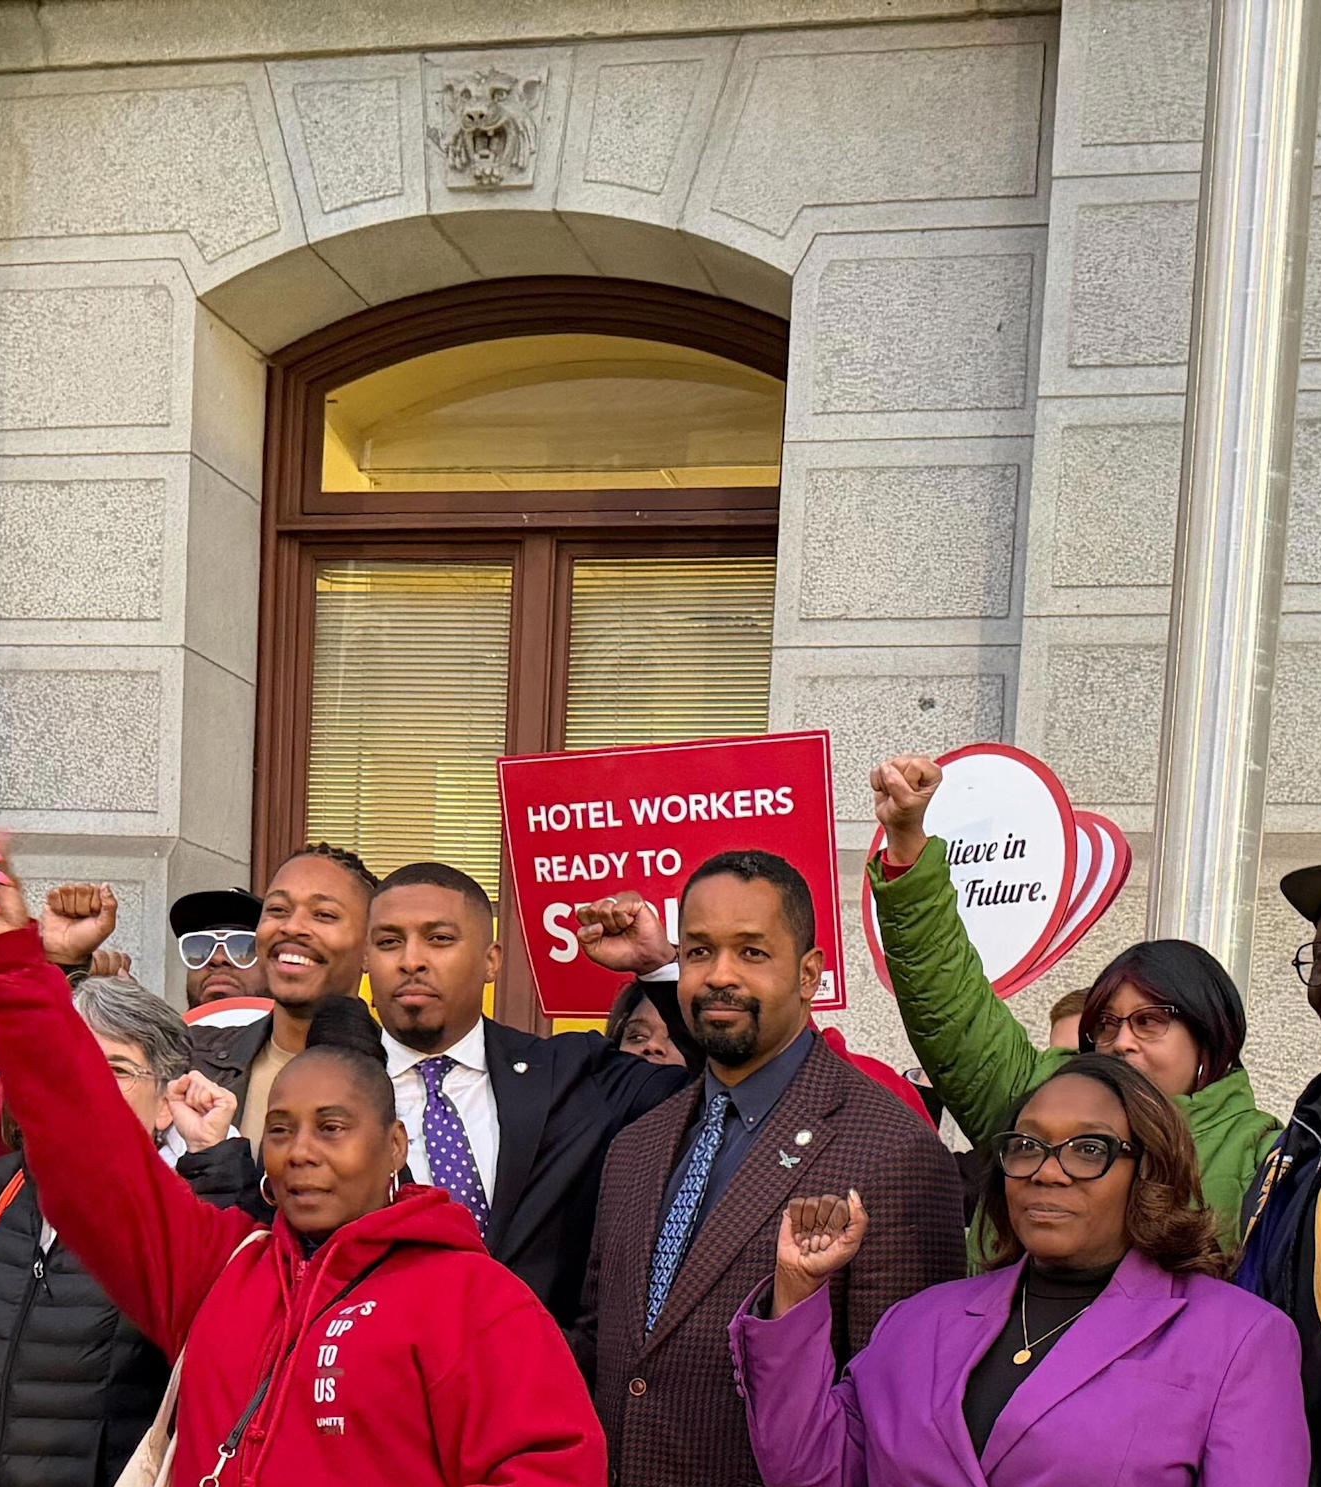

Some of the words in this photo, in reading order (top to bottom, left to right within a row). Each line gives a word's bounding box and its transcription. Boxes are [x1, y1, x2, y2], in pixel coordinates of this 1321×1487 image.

[527, 801, 623, 833] HOTEL
[629, 787, 795, 827] WORKERS
[1003, 833, 1027, 860] in
[533, 852, 630, 883] READY
[636, 849, 682, 877] TO
[965, 878, 1047, 908] Future.
[325, 1319, 354, 1338] UP
[317, 1344, 338, 1368] TO
[314, 1377, 336, 1403] US
